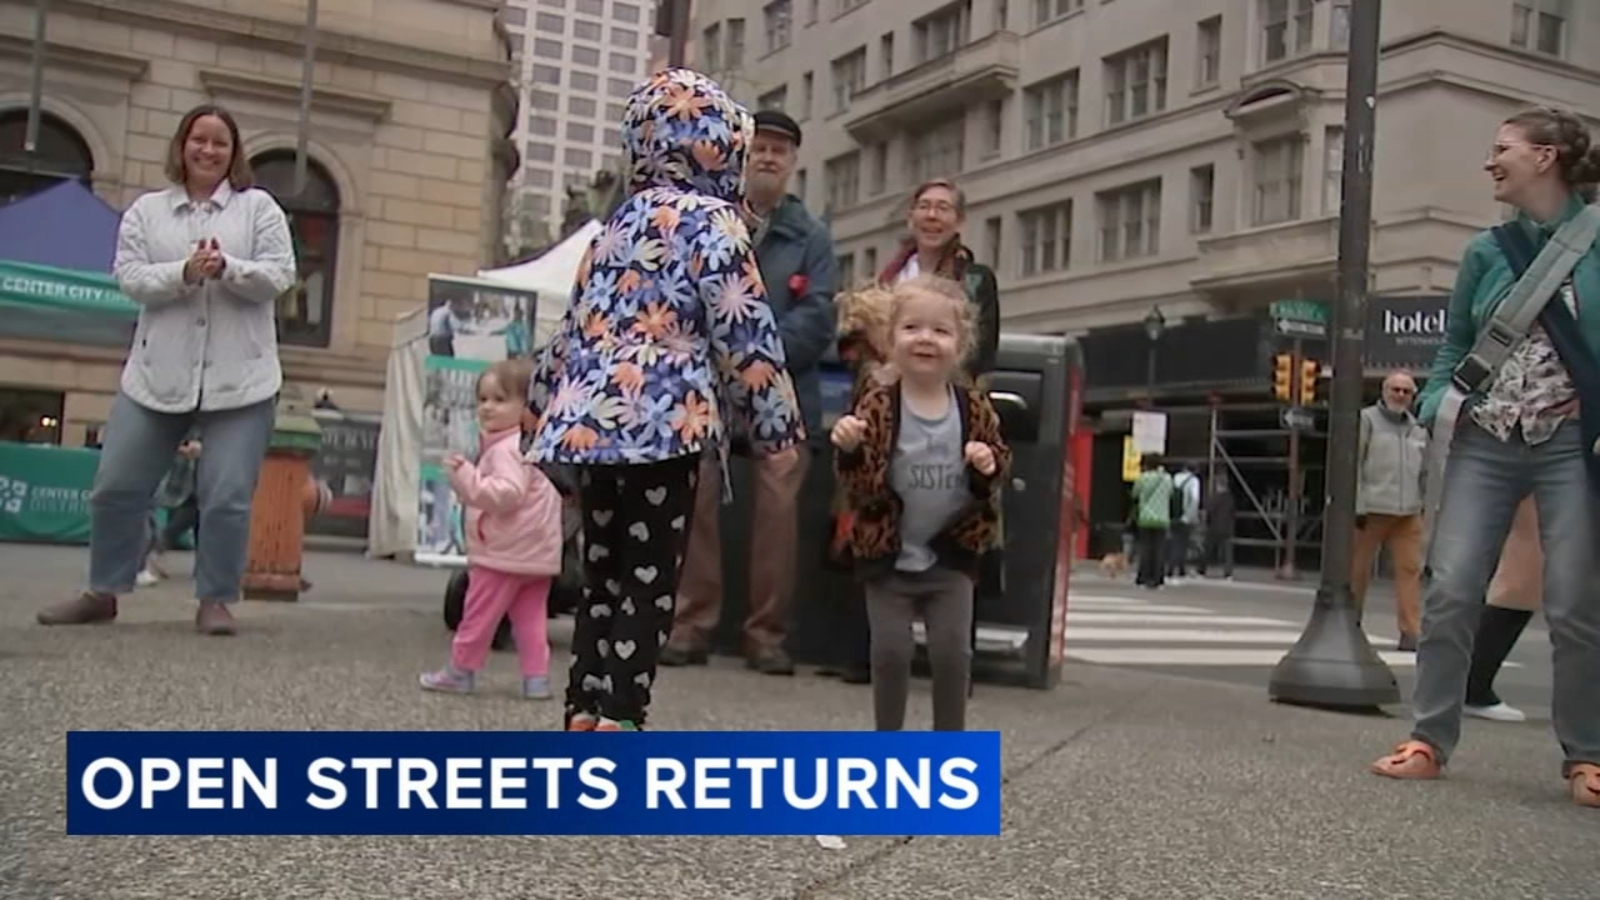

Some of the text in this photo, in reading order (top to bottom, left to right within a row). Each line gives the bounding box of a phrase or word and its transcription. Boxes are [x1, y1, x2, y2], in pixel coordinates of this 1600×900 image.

[2, 277, 67, 297] CENTER
[68, 284, 104, 300] CITY
[1384, 309, 1446, 334] hotel
[31, 486, 79, 500] CENTER
